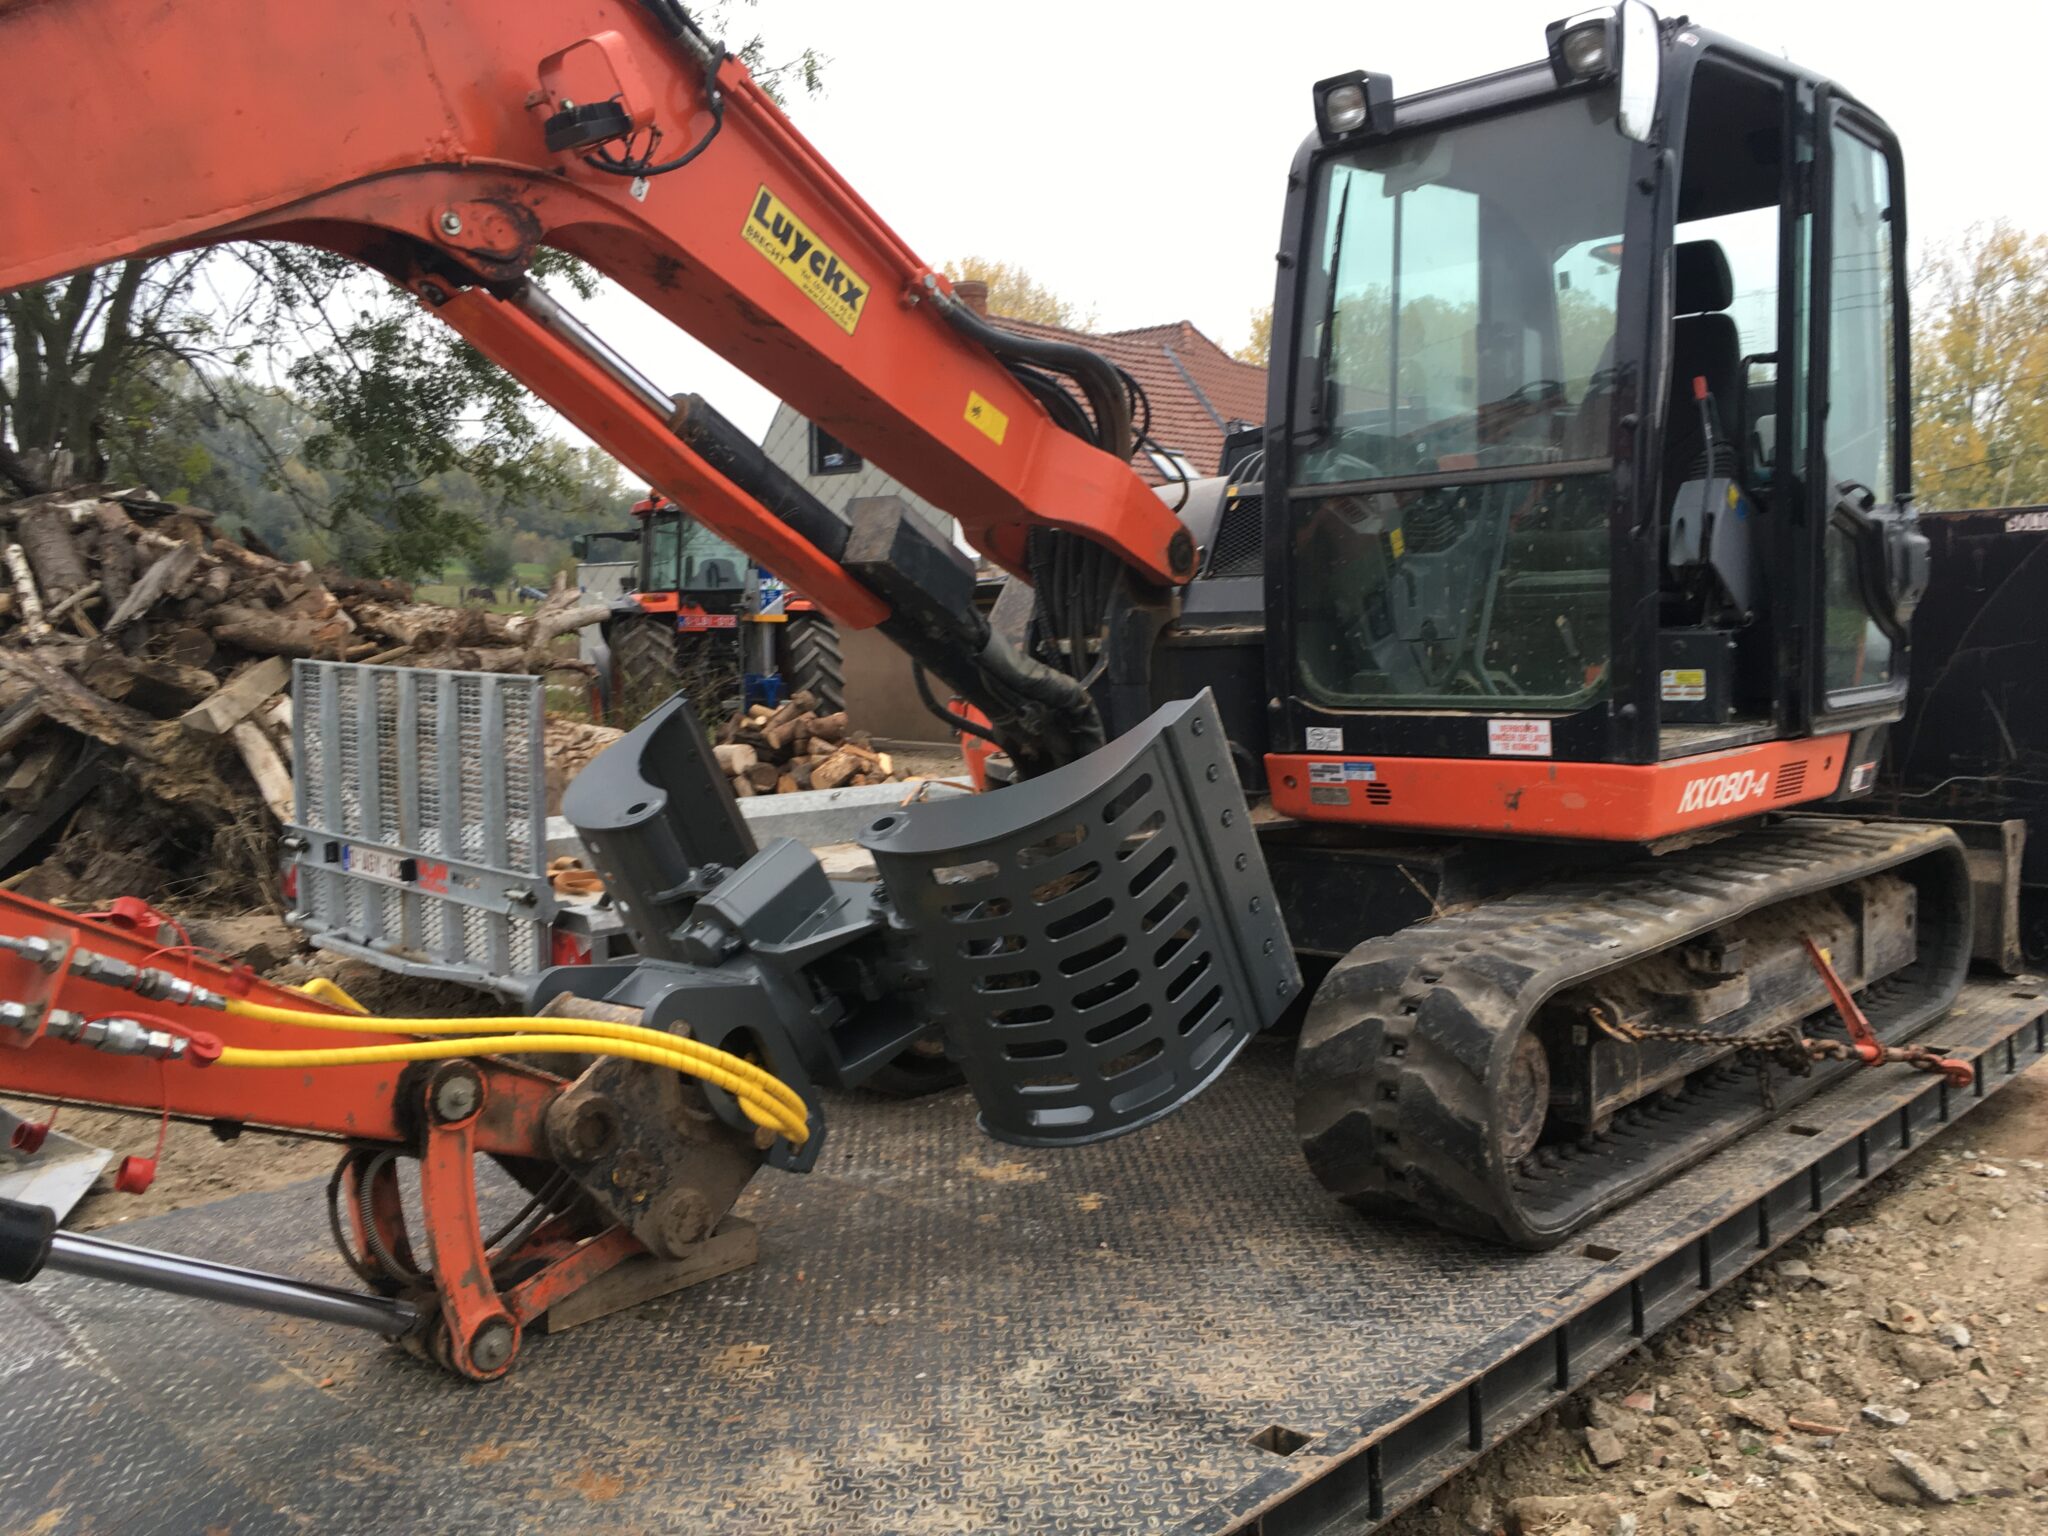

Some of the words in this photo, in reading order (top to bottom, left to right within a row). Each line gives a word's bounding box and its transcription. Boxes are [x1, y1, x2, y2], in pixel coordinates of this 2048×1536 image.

[745, 225, 787, 265] BRECHT
[754, 191, 864, 312] Luyckx
[1676, 769, 1770, 814] KX080-4
